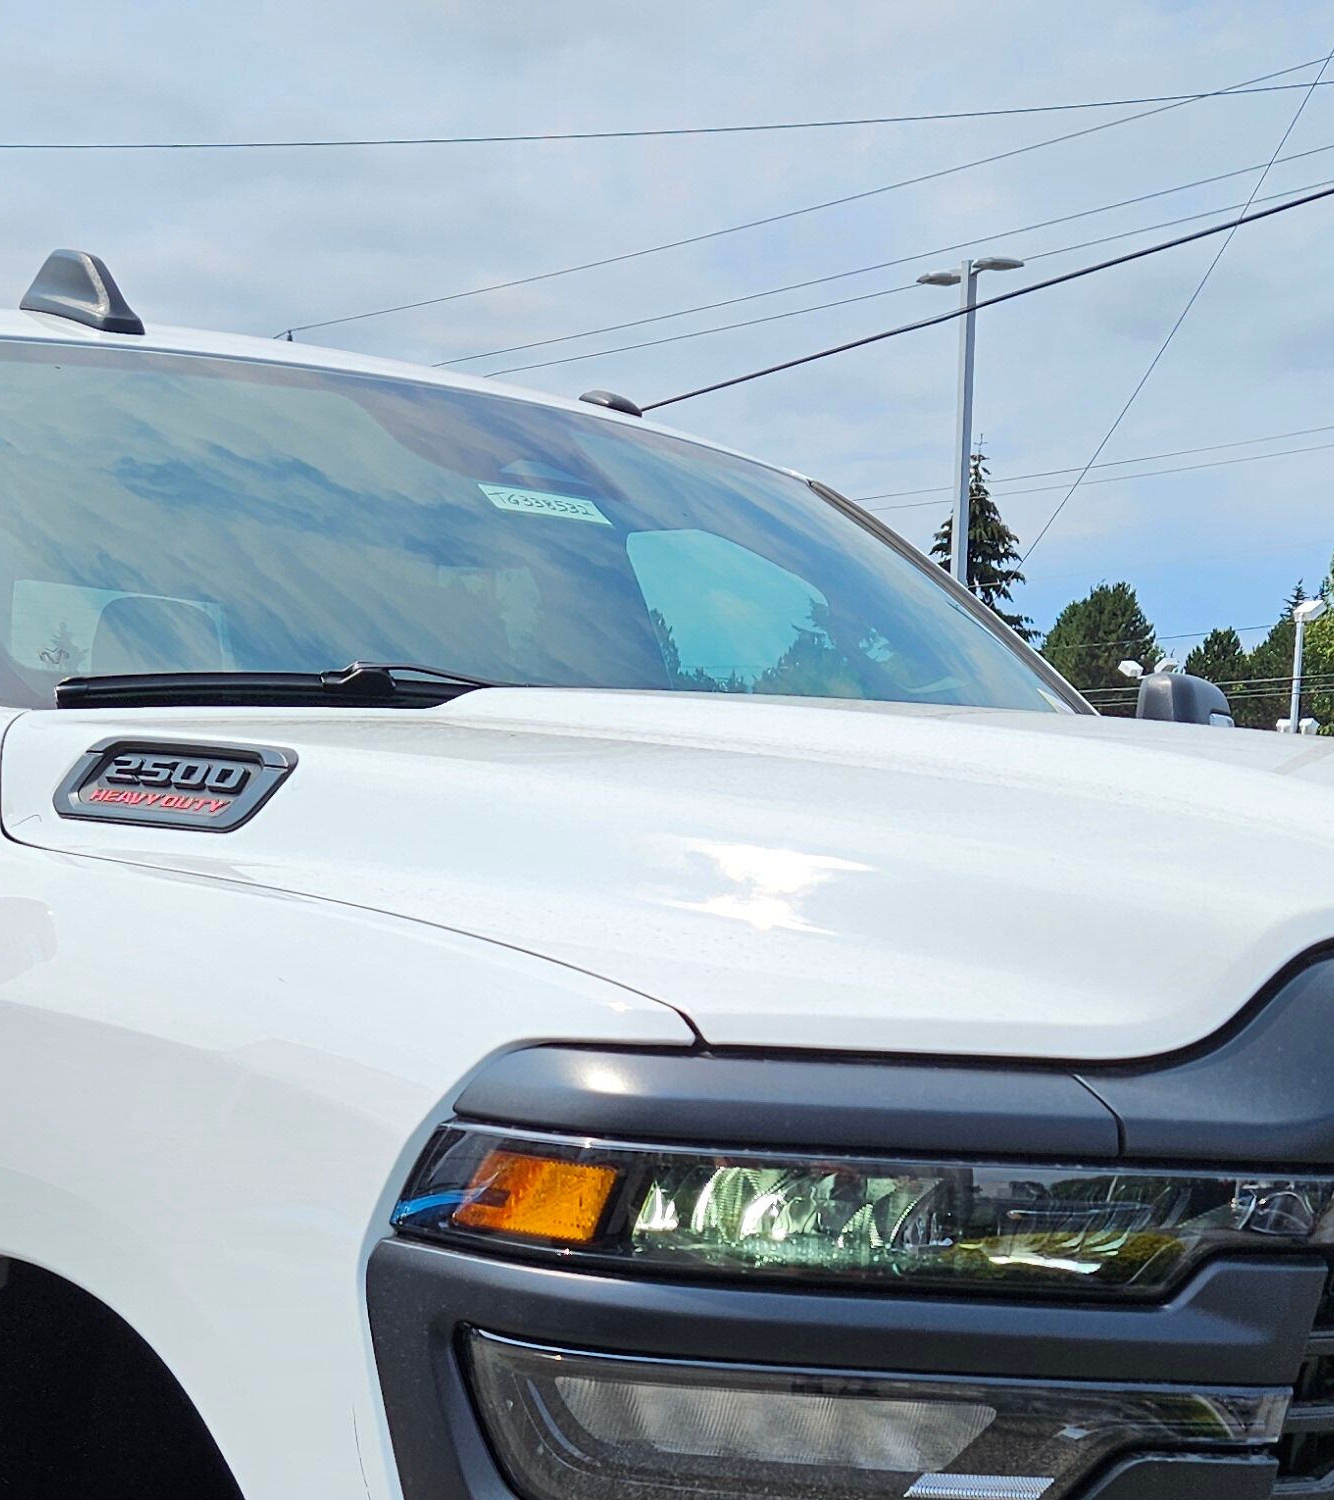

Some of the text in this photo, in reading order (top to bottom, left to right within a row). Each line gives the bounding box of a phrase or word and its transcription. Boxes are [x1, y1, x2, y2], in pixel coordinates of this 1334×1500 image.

[104, 755, 251, 793] 2500
[89, 788, 231, 813] HEAVY DUTY
